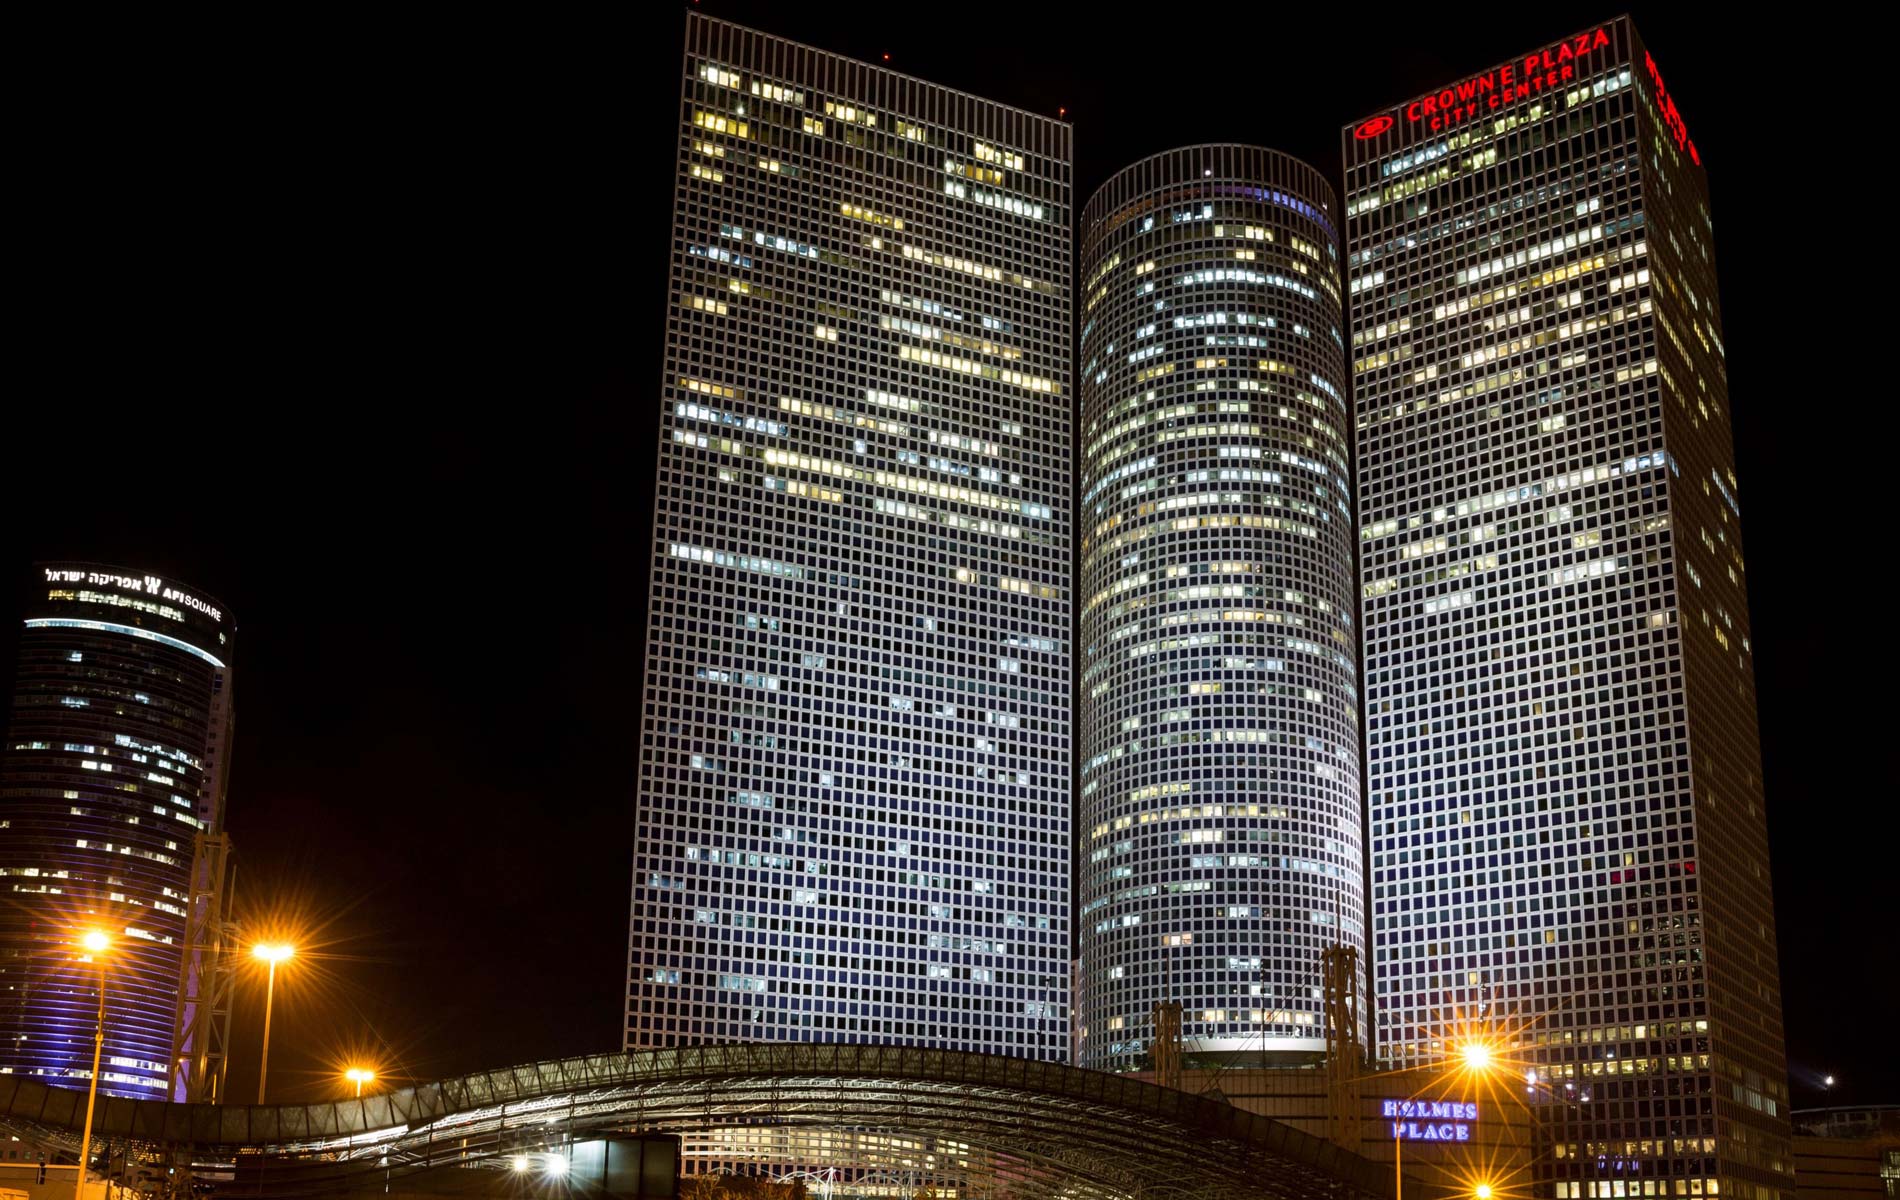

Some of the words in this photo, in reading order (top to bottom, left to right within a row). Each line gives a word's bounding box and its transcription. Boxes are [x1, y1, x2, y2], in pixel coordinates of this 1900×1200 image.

[1407, 65, 1515, 123] CROWNE
[1525, 29, 1610, 76] PLAZA
[1431, 103, 1476, 131] CITY
[1488, 65, 1573, 109] CENTER
[45, 568, 85, 582] ישראל
[88, 572, 142, 591] אפריקה
[1383, 1100, 1477, 1120] HOLMES
[1392, 1121, 1470, 1141] PLACE
